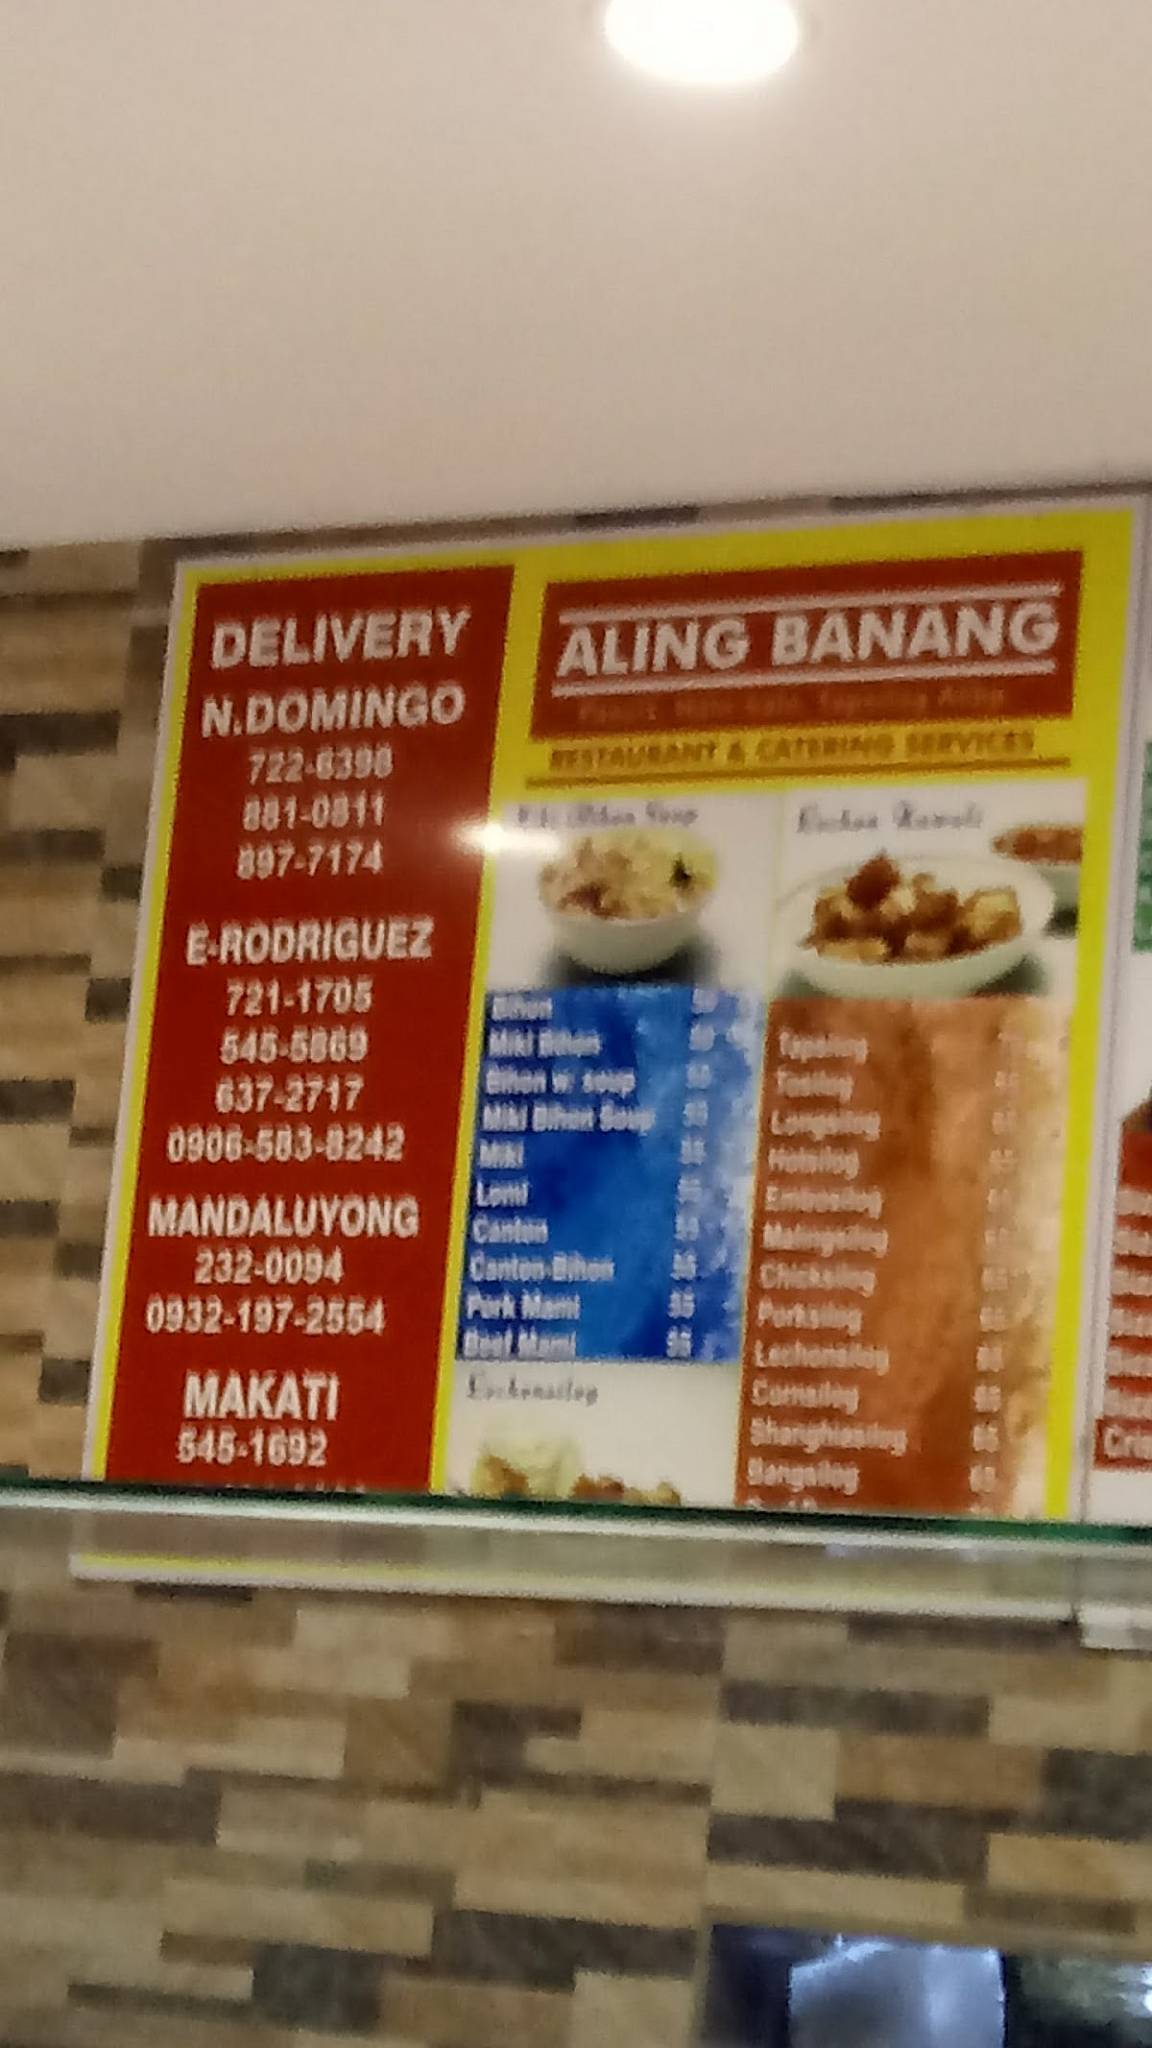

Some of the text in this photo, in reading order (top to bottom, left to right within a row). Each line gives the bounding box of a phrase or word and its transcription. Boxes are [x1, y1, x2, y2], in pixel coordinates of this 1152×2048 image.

[211, 607, 471, 668] DELIVERY
[556, 602, 1060, 678] ALING BANANG
[202, 685, 466, 738] N.DOMINGO
[237, 840, 384, 880] 897-7174
[226, 976, 374, 1017] 721-1705
[215, 1074, 364, 1114] 637-2717
[167, 1123, 405, 1163] 0906-583-8242
[148, 1194, 420, 1239] MANDALUYONG
[194, 1245, 345, 1285] 232-0094
[145, 1292, 386, 1336] 0932-197-2554
[183, 1369, 339, 1421] MAKATI
[176, 1424, 328, 1468] 545-1692
